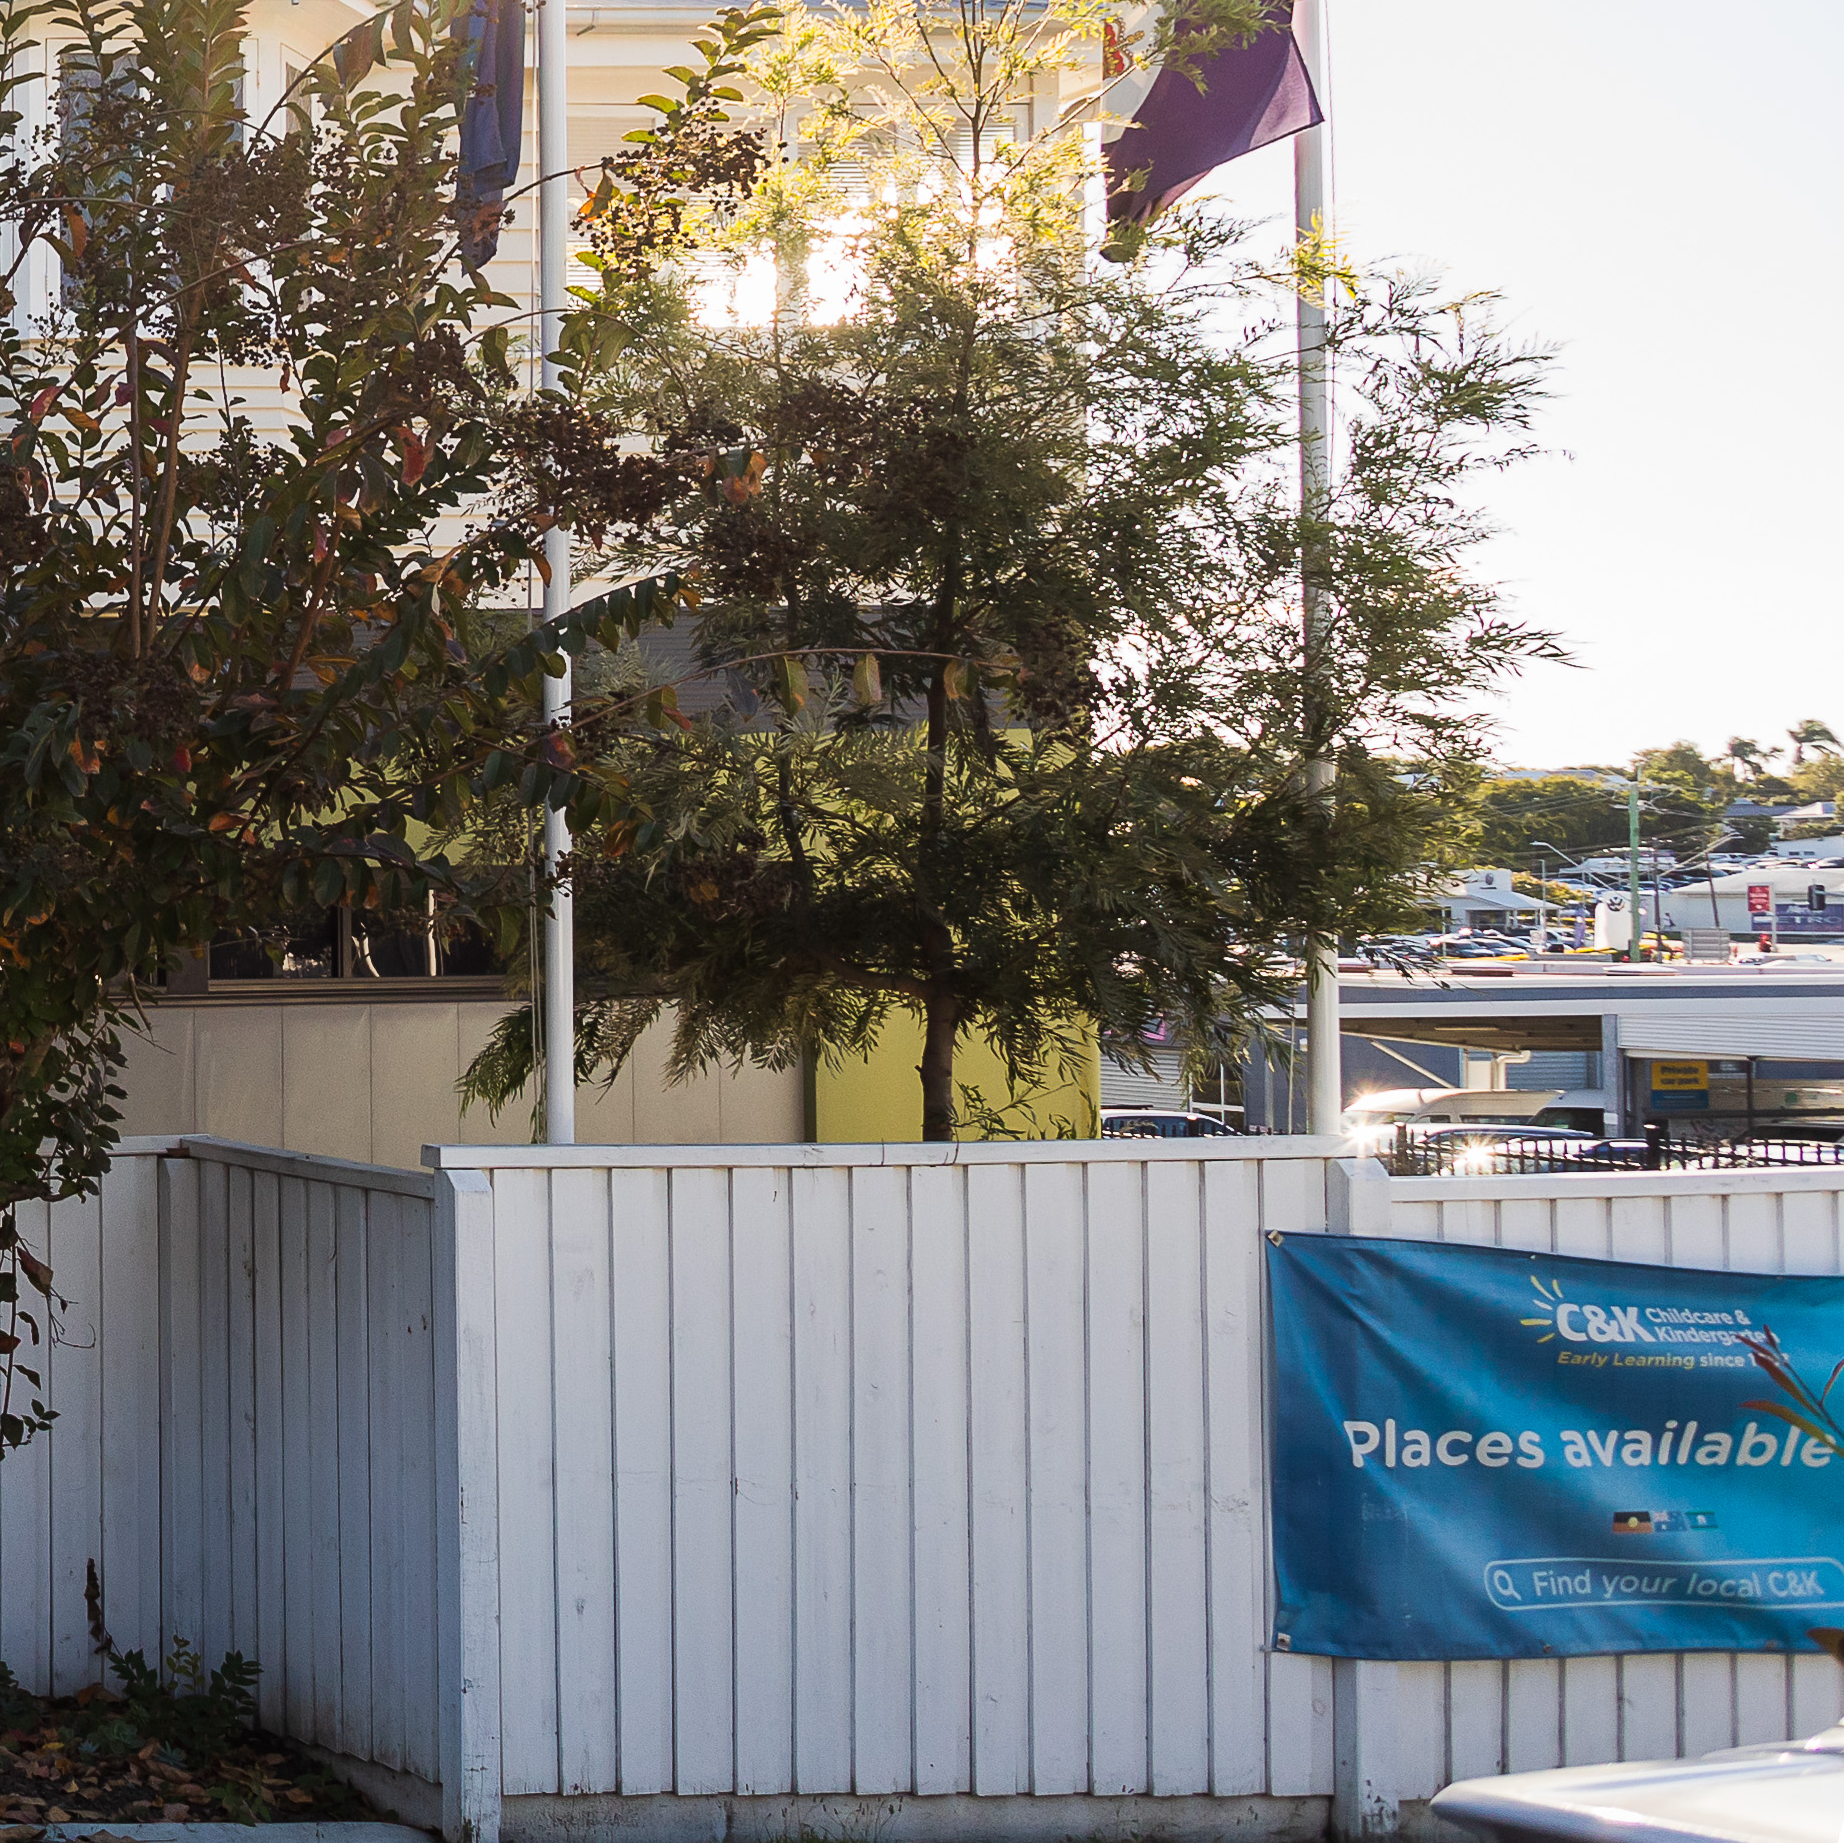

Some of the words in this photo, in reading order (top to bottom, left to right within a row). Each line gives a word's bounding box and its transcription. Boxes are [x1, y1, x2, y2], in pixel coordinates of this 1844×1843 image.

[1556, 1303, 1654, 1343] C&K
[1646, 1307, 1731, 1326] Childcare
[1733, 1310, 1750, 1326] &
[1558, 1351, 1608, 1367] Early
[1613, 1351, 1695, 1370] Learning
[1699, 1353, 1744, 1367] since
[1343, 1419, 1544, 1469] Places
[1563, 1420, 1836, 1469] available
[1532, 1570, 1591, 1598] Find
[1601, 1573, 1673, 1598] your
[1686, 1572, 1760, 1597] local
[1767, 1572, 1825, 1596] C&K
